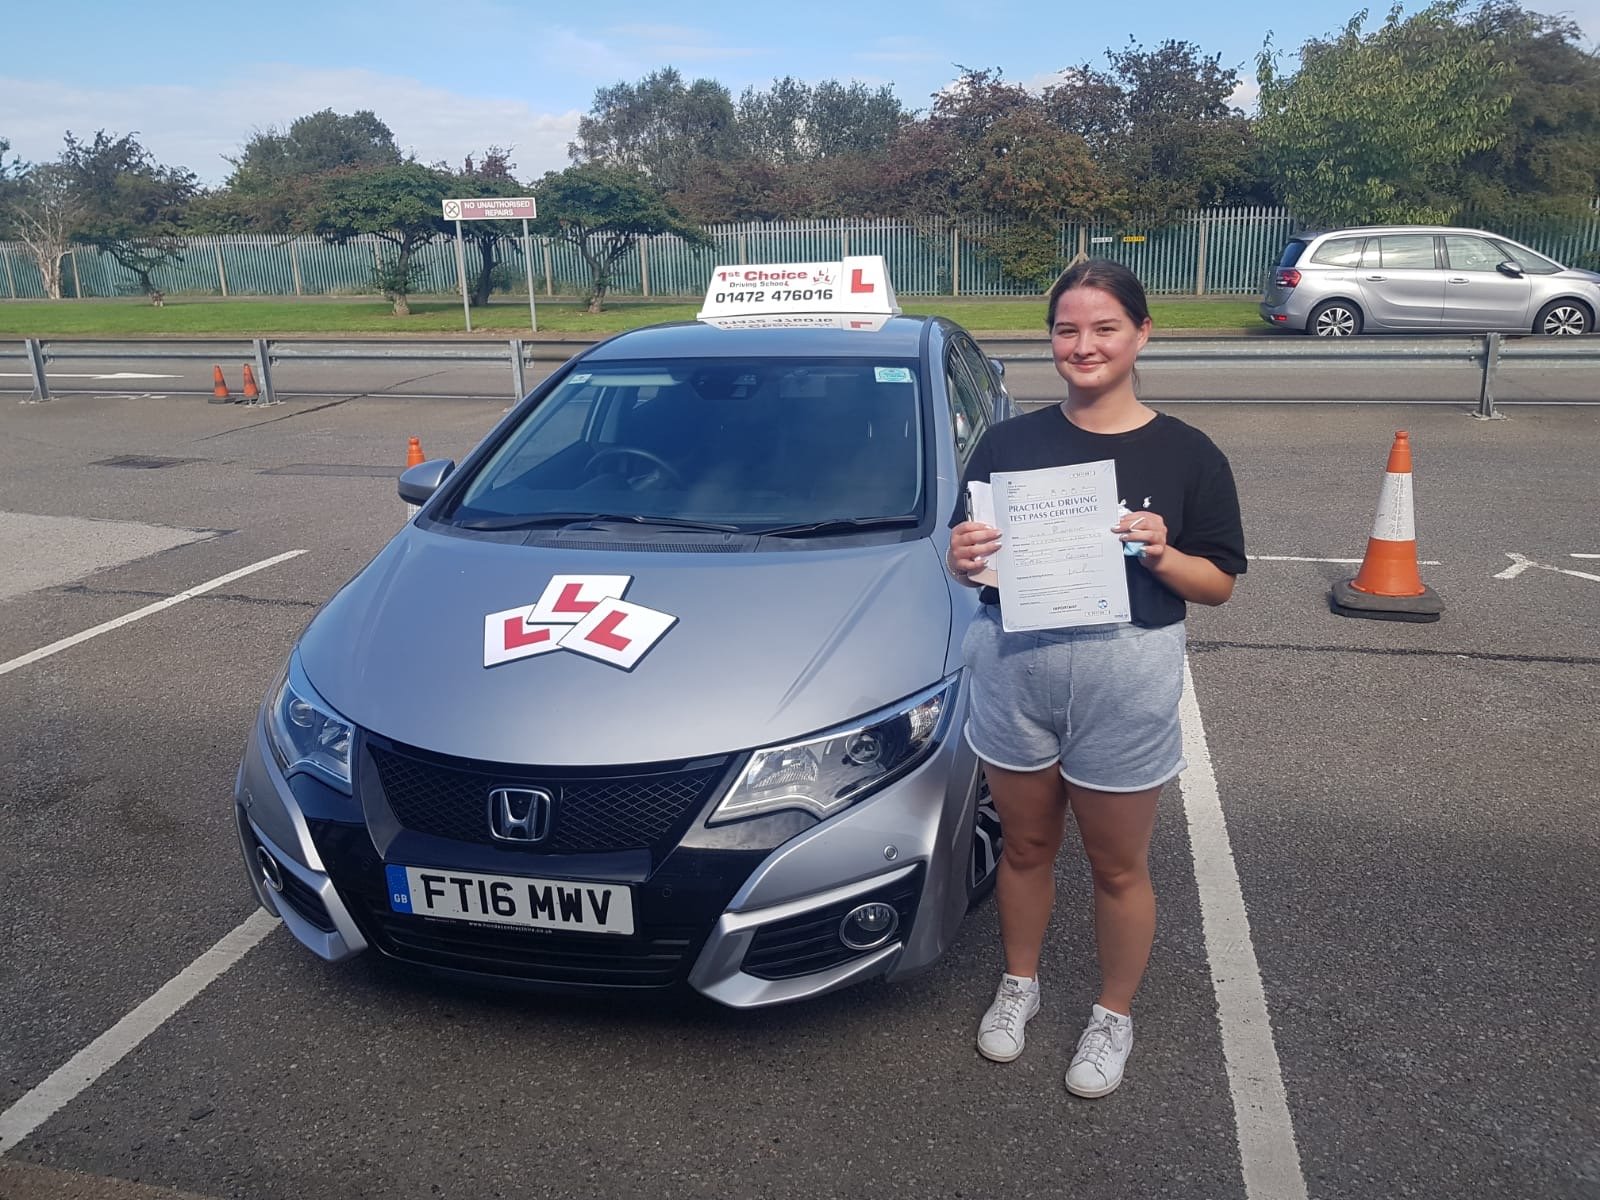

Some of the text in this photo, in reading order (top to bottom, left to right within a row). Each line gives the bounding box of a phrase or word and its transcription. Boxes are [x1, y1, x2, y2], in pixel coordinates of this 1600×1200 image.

[477, 200, 530, 209] UNAUTHORISED
[484, 209, 514, 217] REPAIRS
[717, 270, 808, 282] 1st Choice
[851, 269, 875, 293] L
[715, 289, 833, 304] 01472 476016
[1008, 495, 1098, 513] PRACTICAL DRIVING
[1009, 505, 1098, 522] TEST PASS CERTIFICATE
[551, 583, 600, 612] L
[504, 616, 550, 650] L
[584, 610, 632, 651] L
[393, 893, 408, 904] GB
[420, 873, 612, 925] FT16 MWV
